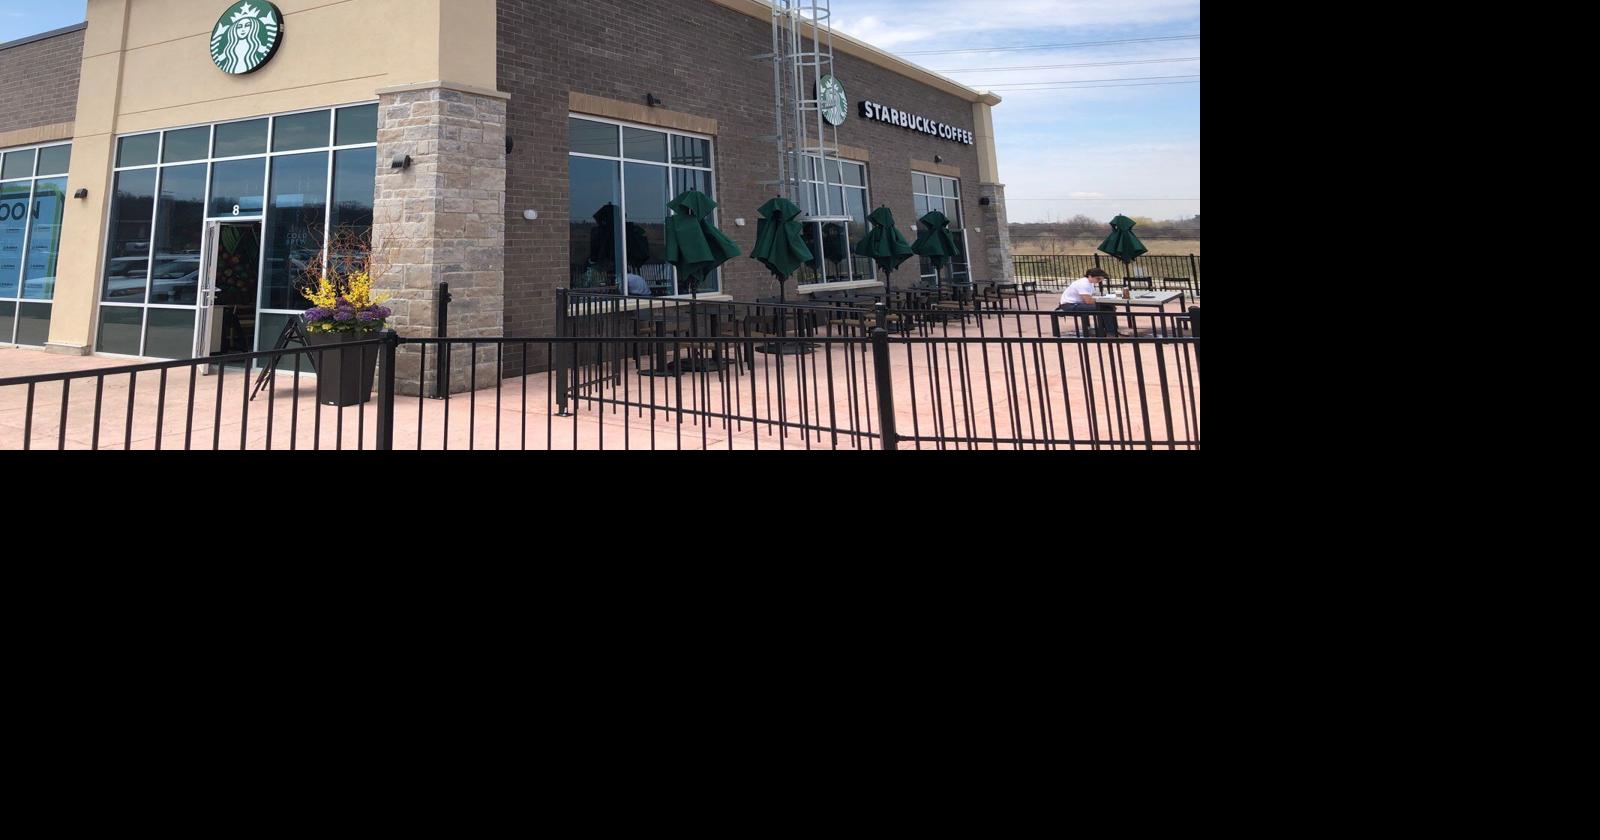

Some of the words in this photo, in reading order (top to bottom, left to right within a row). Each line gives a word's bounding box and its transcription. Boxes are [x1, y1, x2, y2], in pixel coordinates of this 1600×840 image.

[863, 100, 938, 136] STARBUCKS
[938, 122, 974, 145] COFFEE
[232, 204, 240, 216] 8
